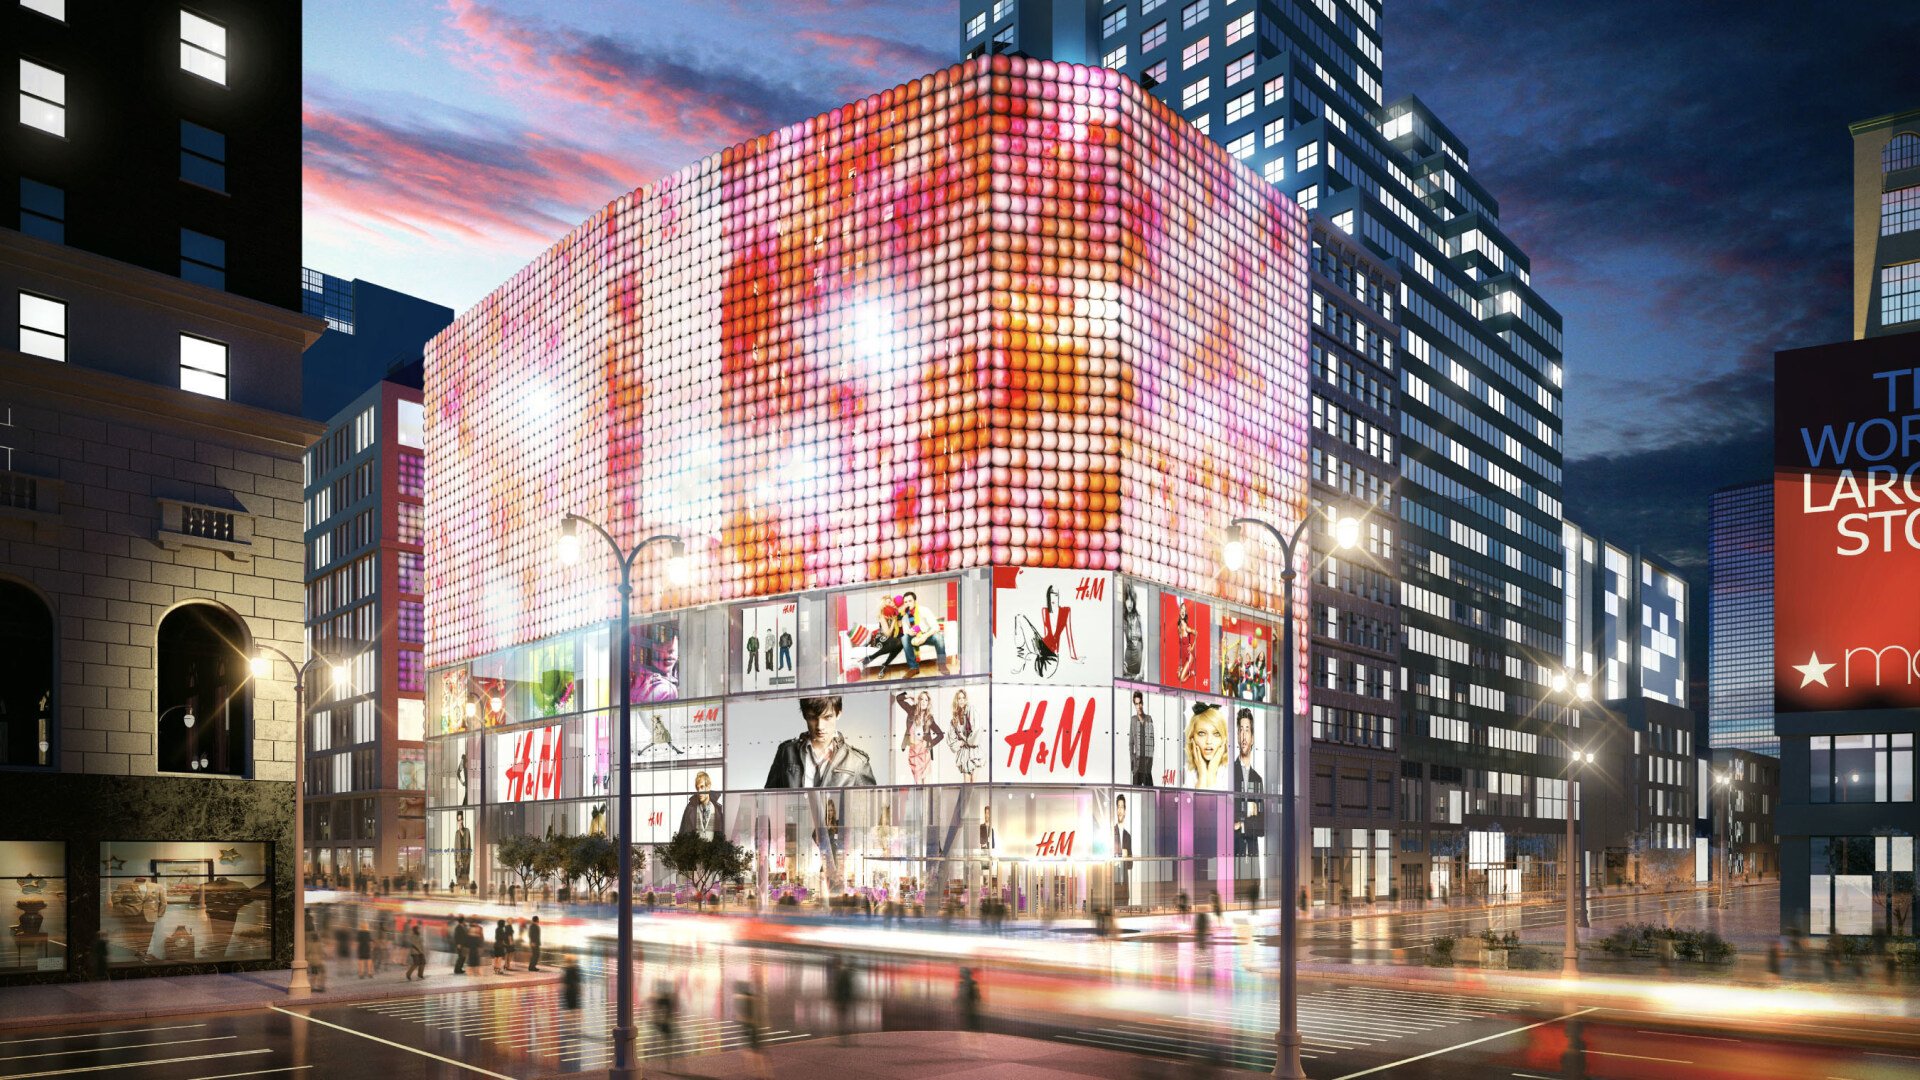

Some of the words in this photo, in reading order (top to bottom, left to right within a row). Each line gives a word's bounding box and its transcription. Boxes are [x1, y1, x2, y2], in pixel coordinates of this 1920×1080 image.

[1872, 367, 1920, 412] T
[1075, 577, 1105, 601] H&M
[1845, 645, 1920, 688] m
[1004, 696, 1095, 777] H&M
[505, 726, 562, 802] H&M
[1036, 830, 1075, 856] H&M
